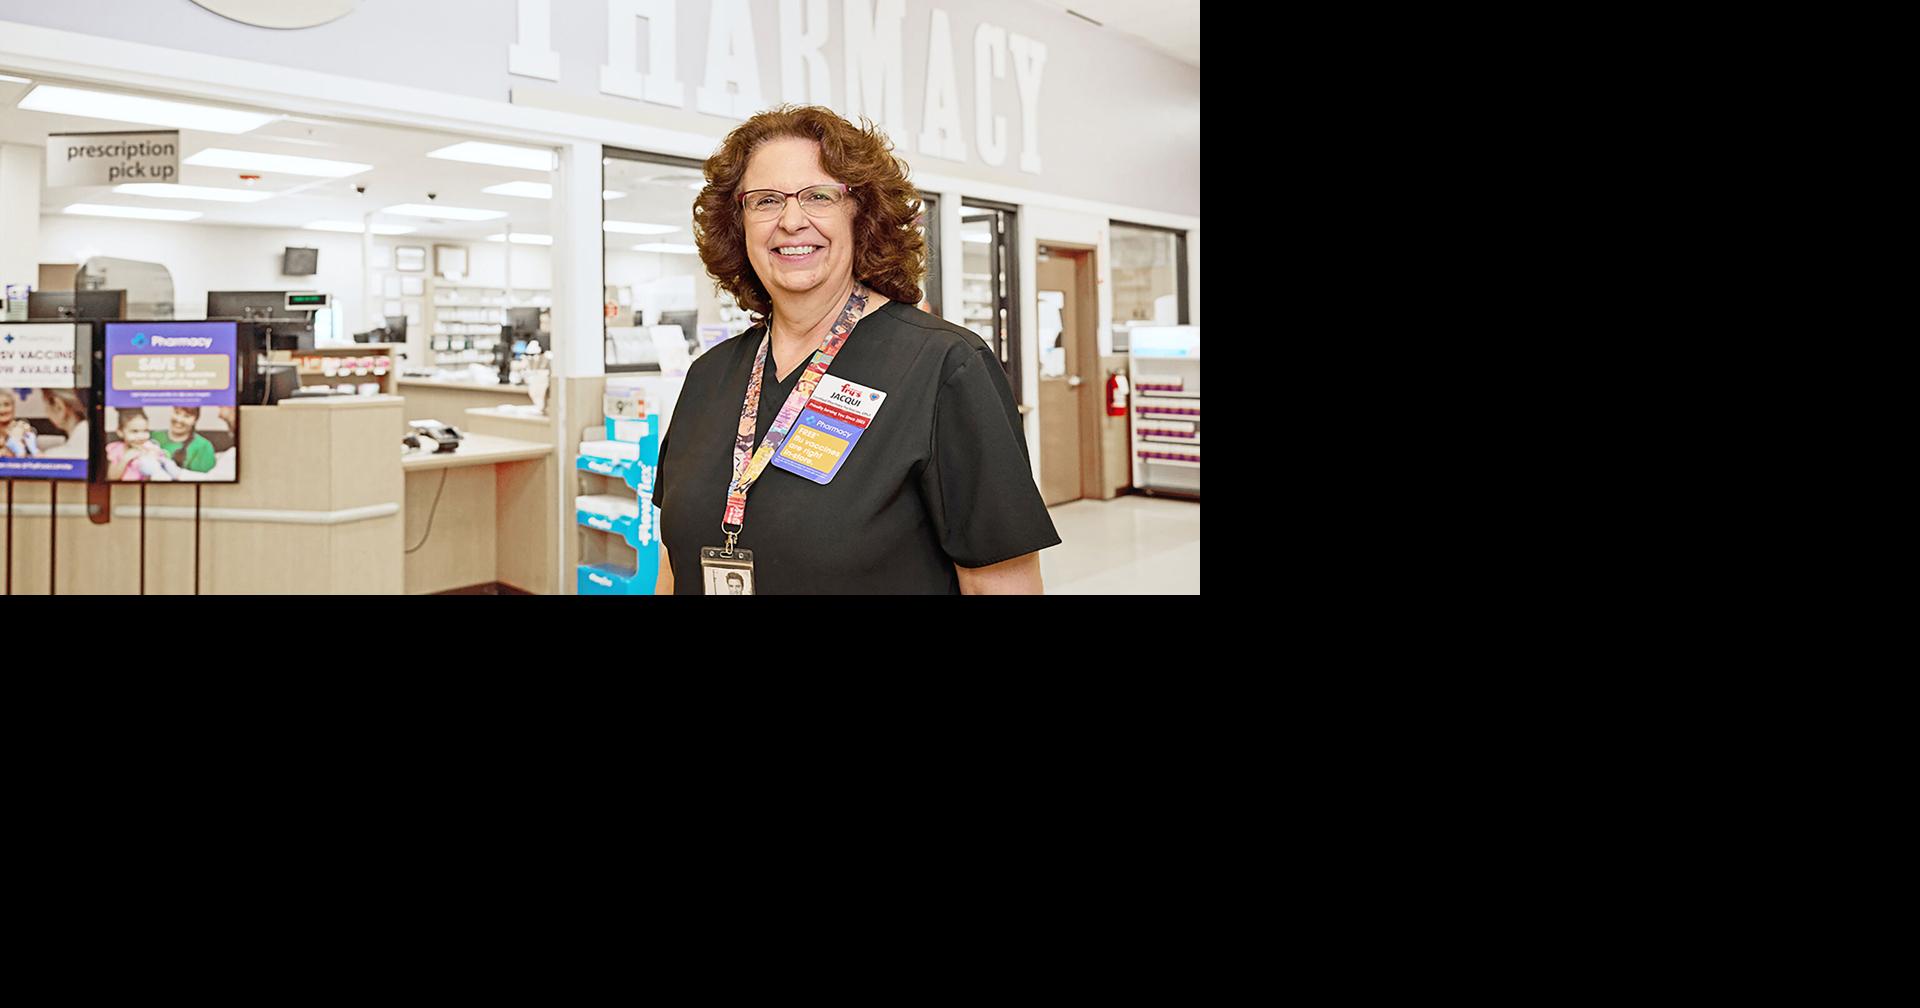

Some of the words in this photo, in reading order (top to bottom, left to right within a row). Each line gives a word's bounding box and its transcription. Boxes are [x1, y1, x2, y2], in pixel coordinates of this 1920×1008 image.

[67, 140, 175, 161] prescription
[108, 161, 146, 182] pick
[150, 165, 174, 181] up
[151, 335, 213, 349] Pharmacy
[138, 357, 176, 371] SAVE
[830, 392, 861, 407] JACQUI
[816, 420, 853, 438] Pharmacy
[788, 443, 803, 451] are
[803, 447, 823, 460] right
[805, 440, 841, 457] vaccines
